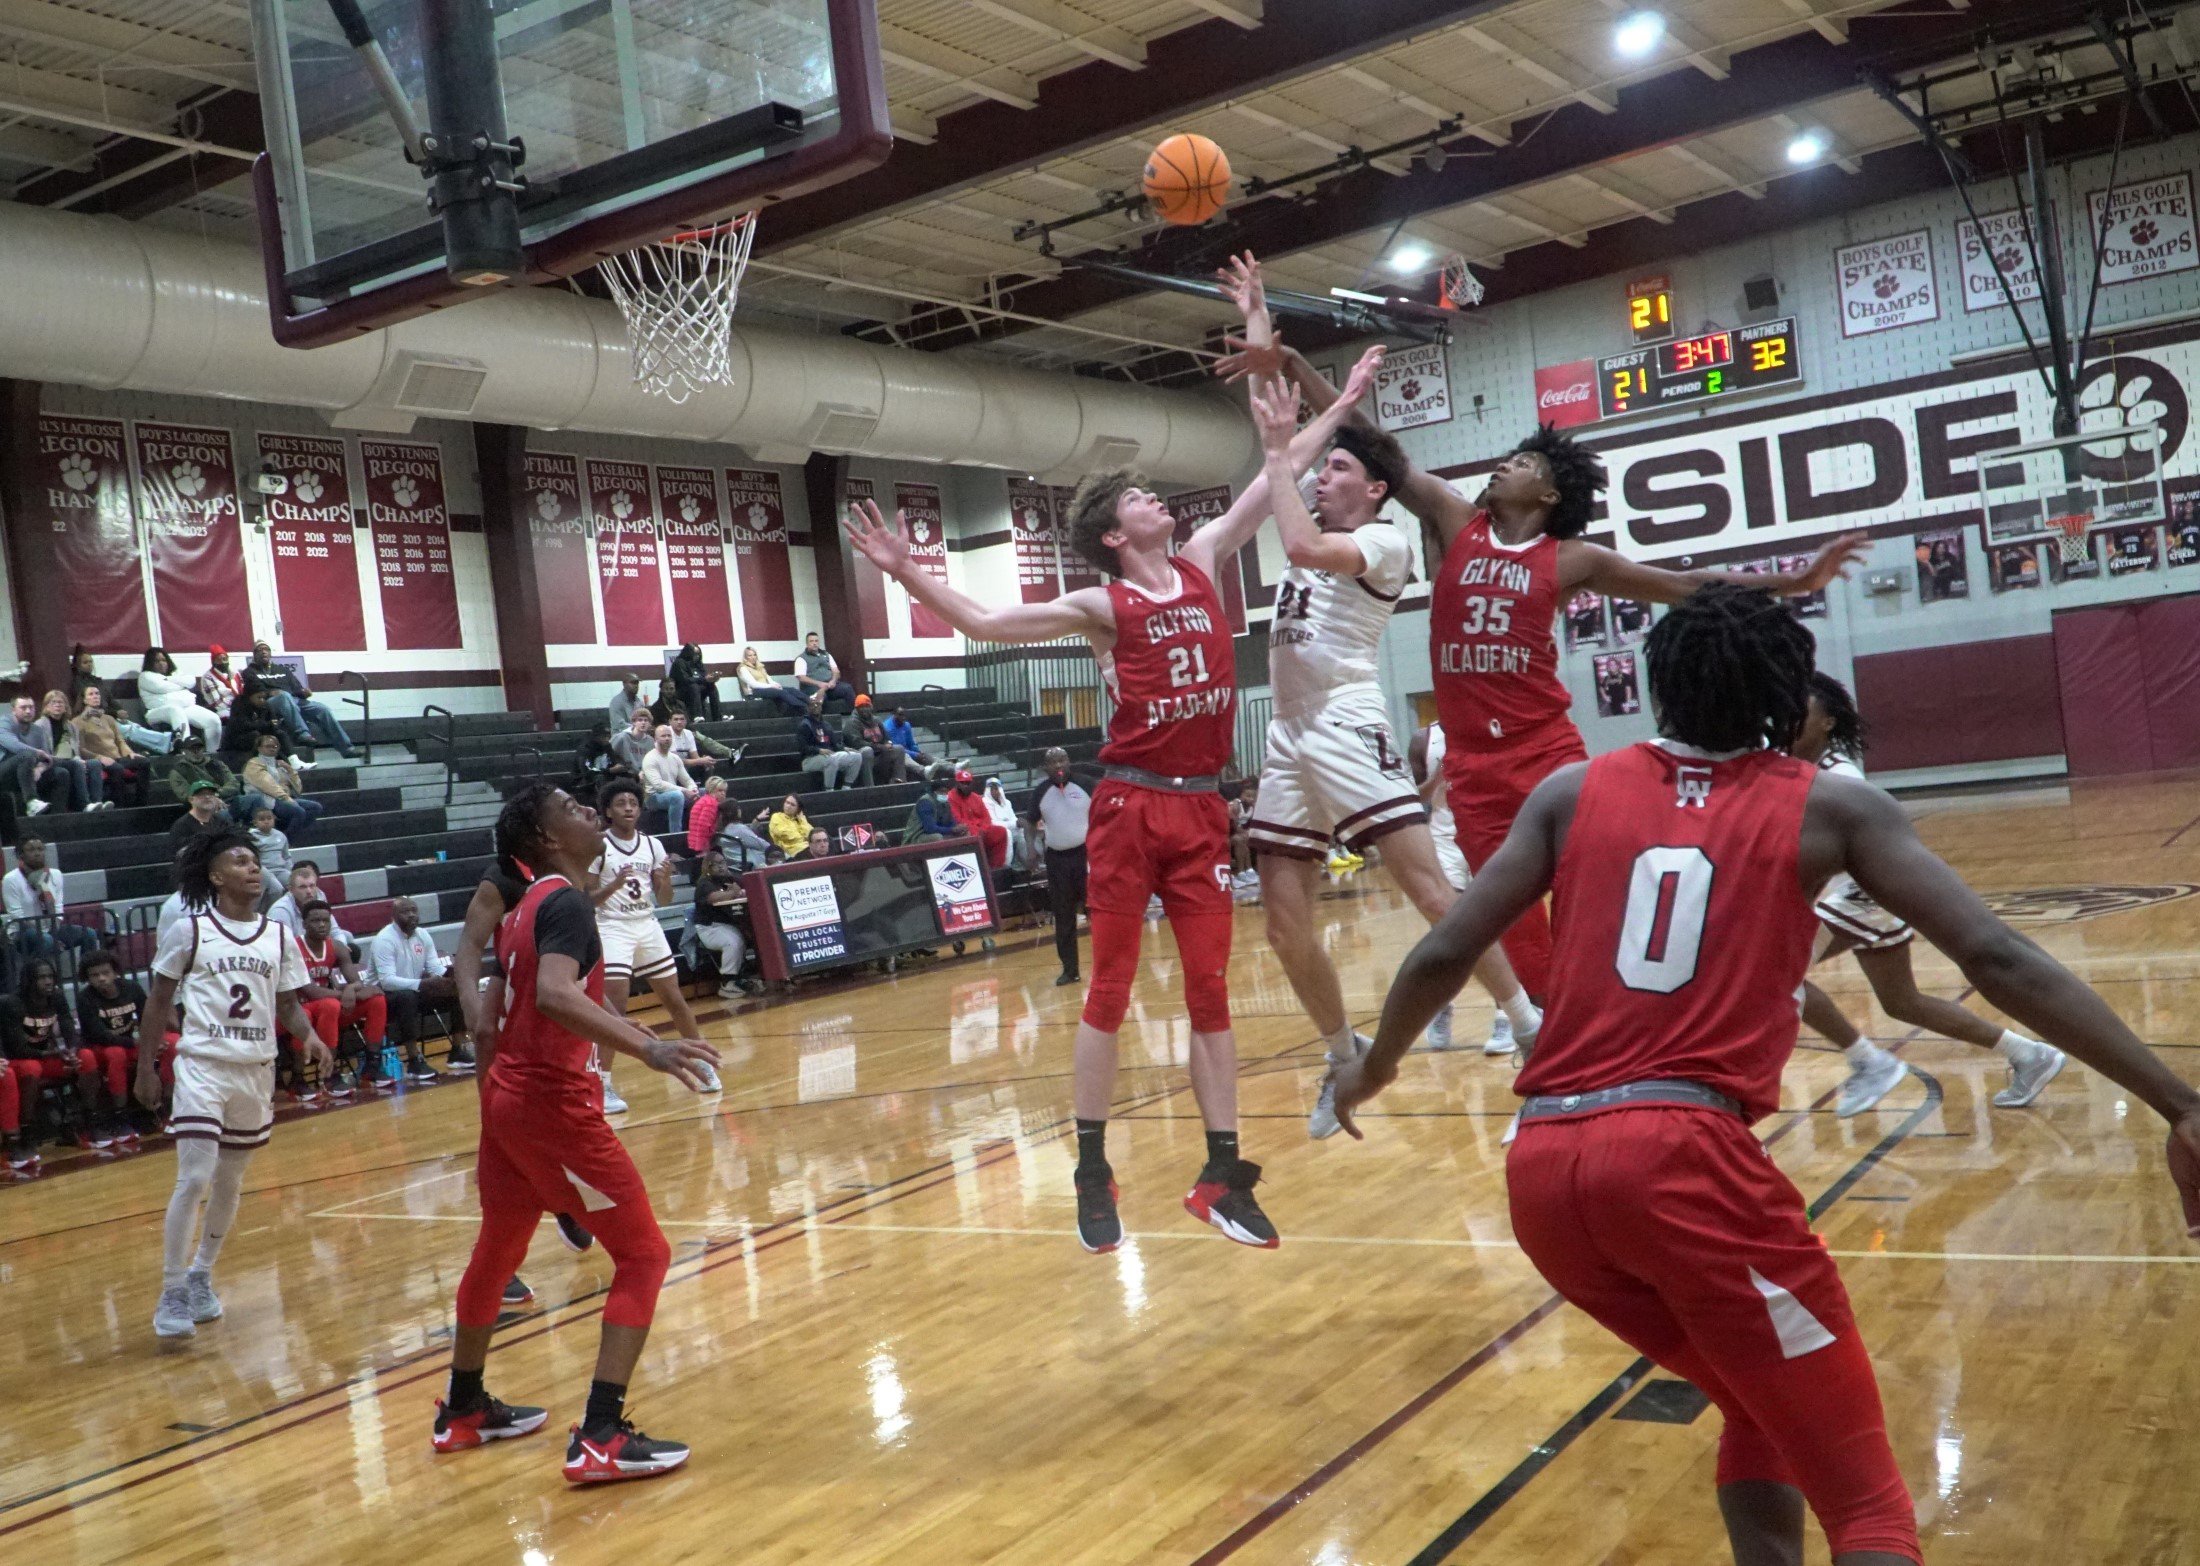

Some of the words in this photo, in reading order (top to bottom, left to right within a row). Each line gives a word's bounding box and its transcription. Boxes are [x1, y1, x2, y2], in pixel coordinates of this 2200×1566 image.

[2096, 189, 2140, 211] GRLS
[2144, 180, 2183, 201] GOLF
[2099, 196, 2187, 232] STATE
[1964, 219, 2003, 238] BYS
[1841, 245, 1882, 266] BOYS
[1884, 235, 1924, 256] GOLF
[2103, 231, 2192, 267] CHAMPS
[1845, 252, 1926, 288] STATE
[2132, 259, 2166, 275] 2012
[1847, 284, 1930, 319] CHAMPS
[1997, 287, 2031, 301] 210
[1631, 294, 1669, 329] 21
[1874, 312, 1906, 326] 2007
[1741, 322, 1788, 341] PANTHERS
[1379, 353, 1407, 370] OYS
[1409, 346, 1439, 363] GOLF
[1604, 352, 1647, 370] GUEST
[1674, 333, 1730, 371] 3:47
[1752, 338, 1786, 370] 32
[1378, 361, 1442, 391] STATE
[1613, 368, 1647, 399] 21
[1661, 381, 1701, 397] PERIOD
[1707, 370, 1722, 393] 2
[1382, 390, 1445, 418] CHAMPS
[1403, 413, 1427, 425] 2006
[61, 422, 122, 438] LACROSSE
[173, 431, 228, 446] LACROSSE
[41, 435, 120, 462] EGION
[143, 442, 227, 469] REGION
[261, 437, 298, 450] GIRL'S
[301, 439, 344, 454] TENNIS
[364, 444, 398, 458] BOY'S
[400, 447, 438, 461] TENNIS
[268, 452, 342, 477] REGION
[369, 460, 437, 482] REGION
[591, 464, 645, 478] BASEBALL
[659, 469, 712, 481] VOLLEYBALL
[526, 476, 576, 499] EGION
[592, 476, 647, 496] REGION
[662, 481, 713, 500] REGION
[271, 499, 350, 523] CHAMPS
[731, 490, 780, 511] REGION
[1178, 500, 1224, 521] AREA
[372, 502, 445, 525] CHAMPS
[595, 514, 654, 534] CHAMPS
[529, 516, 583, 534] HAMPS
[665, 518, 720, 537] CHAMPS
[734, 525, 786, 543] CHAMPS
[1014, 526, 1055, 541] CHAMPS
[275, 531, 296, 541] 2017
[304, 532, 325, 543] 2018
[332, 533, 352, 544] 2019
[277, 546, 298, 556] 2021
[307, 547, 328, 557] 2022
[909, 541, 944, 557] HAMPS
[1459, 558, 1531, 596] GLYNN
[1145, 606, 1213, 644] GLYNN
[1462, 595, 1515, 635] 35
[1167, 643, 1210, 688] 21
[1440, 642, 1532, 674] ACADEMY
[1147, 687, 1231, 730] ACADEMY
[627, 879, 641, 900] 3
[795, 884, 830, 896] PREMIER
[797, 894, 832, 906] NETWORX
[1614, 845, 1715, 994] 0
[787, 932, 809, 941] YOUR
[797, 937, 836, 949] TRUSTED.
[792, 953, 801, 963] IT
[802, 944, 845, 961] PROVIDER
[206, 956, 273, 979] LAKESIDE
[228, 983, 252, 1020] 2
[209, 1023, 267, 1041] PANTHERS
